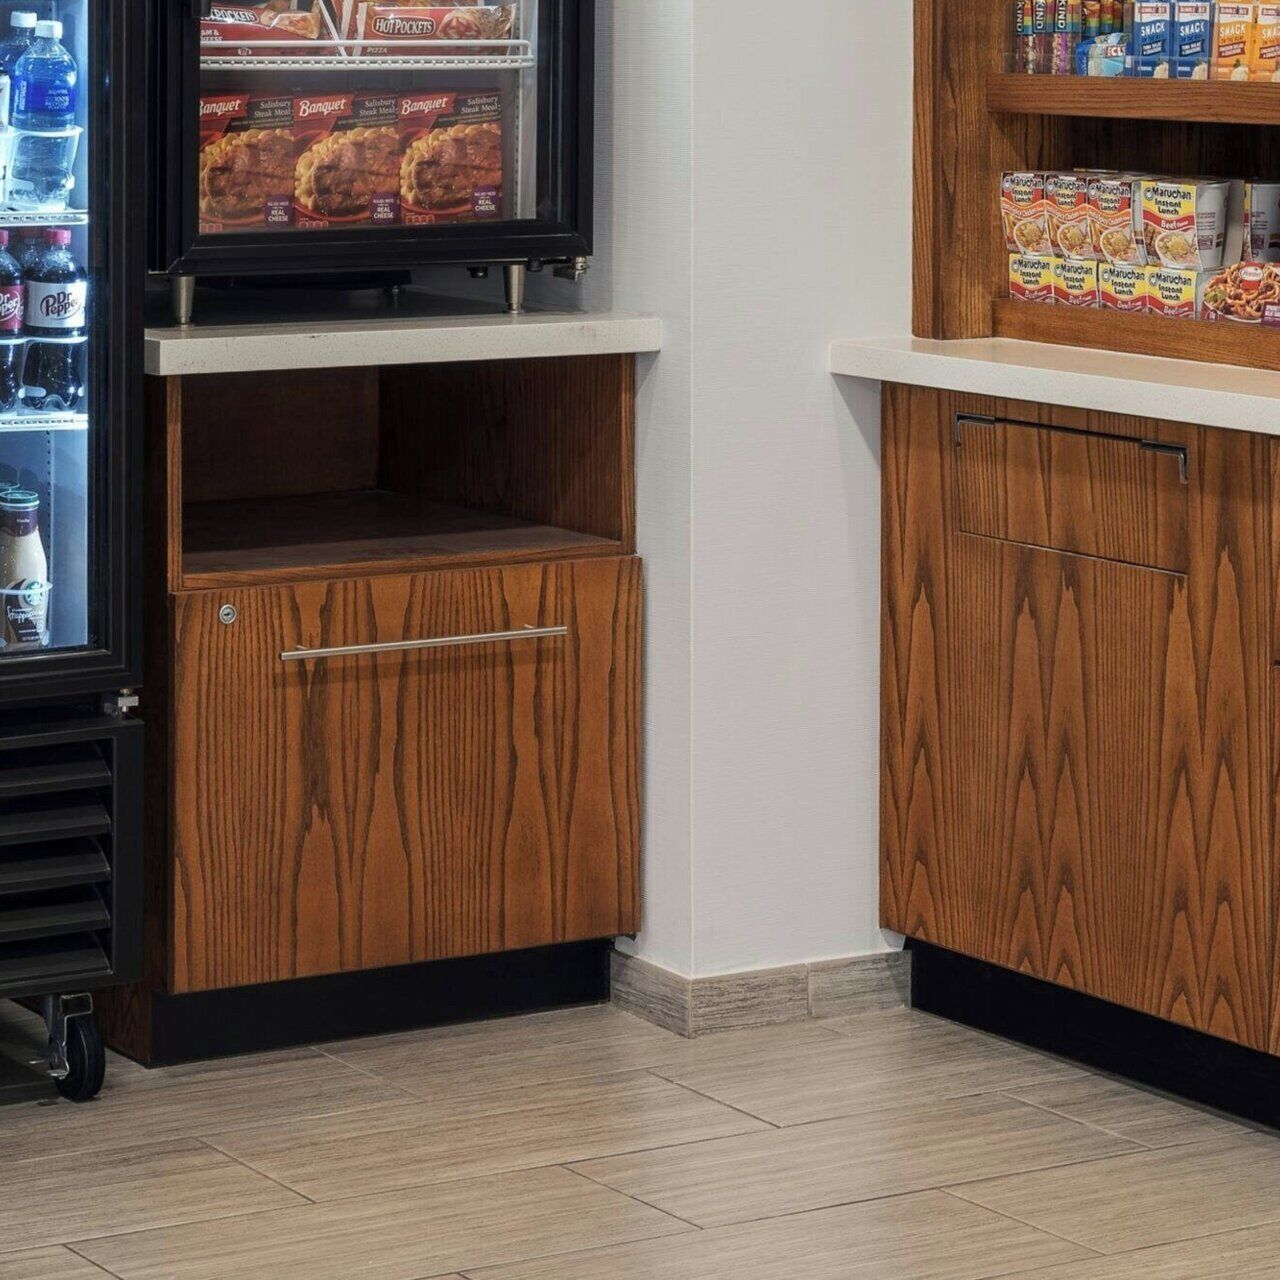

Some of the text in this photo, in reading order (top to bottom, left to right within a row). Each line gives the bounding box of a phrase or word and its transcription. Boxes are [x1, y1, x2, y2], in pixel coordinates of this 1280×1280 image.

[376, 19, 433, 33] HOT POCKETS
[1140, 22, 1166, 36] SNACK
[1220, 24, 1246, 37] SNACK
[260, 100, 291, 109] Salisbury
[365, 99, 396, 109] Salisbury
[401, 97, 448, 115] Banquet
[467, 96, 499, 106] Salisbury
[299, 99, 346, 117] Banquet
[359, 107, 396, 117] Steak Meal
[254, 110, 272, 118] Steak
[1011, 177, 1043, 188] Maruchan
[1053, 179, 1085, 191] Maruchan
[1096, 183, 1129, 196] Maruchan
[1153, 186, 1191, 200] Maruchan
[1155, 198, 1182, 208] Instant
[1158, 206, 1179, 215] Lunch
[1161, 220, 1177, 230] Beef
[1018, 259, 1050, 270] Maruchan
[1061, 264, 1093, 275] Maruchan
[1020, 270, 1041, 278] Instant
[1063, 274, 1085, 284] Instant
[1109, 268, 1145, 280] Maruchan
[1023, 277, 1039, 285] Lunch
[1111, 280, 1135, 289] Instant
[1155, 273, 1191, 286] Maruchan
[1066, 282, 1083, 290] Lunch
[1114, 287, 1133, 295] Lunch
[1158, 284, 1182, 294] Instant
[56, 291, 73, 304] Dr
[1161, 292, 1180, 300] Lunch
